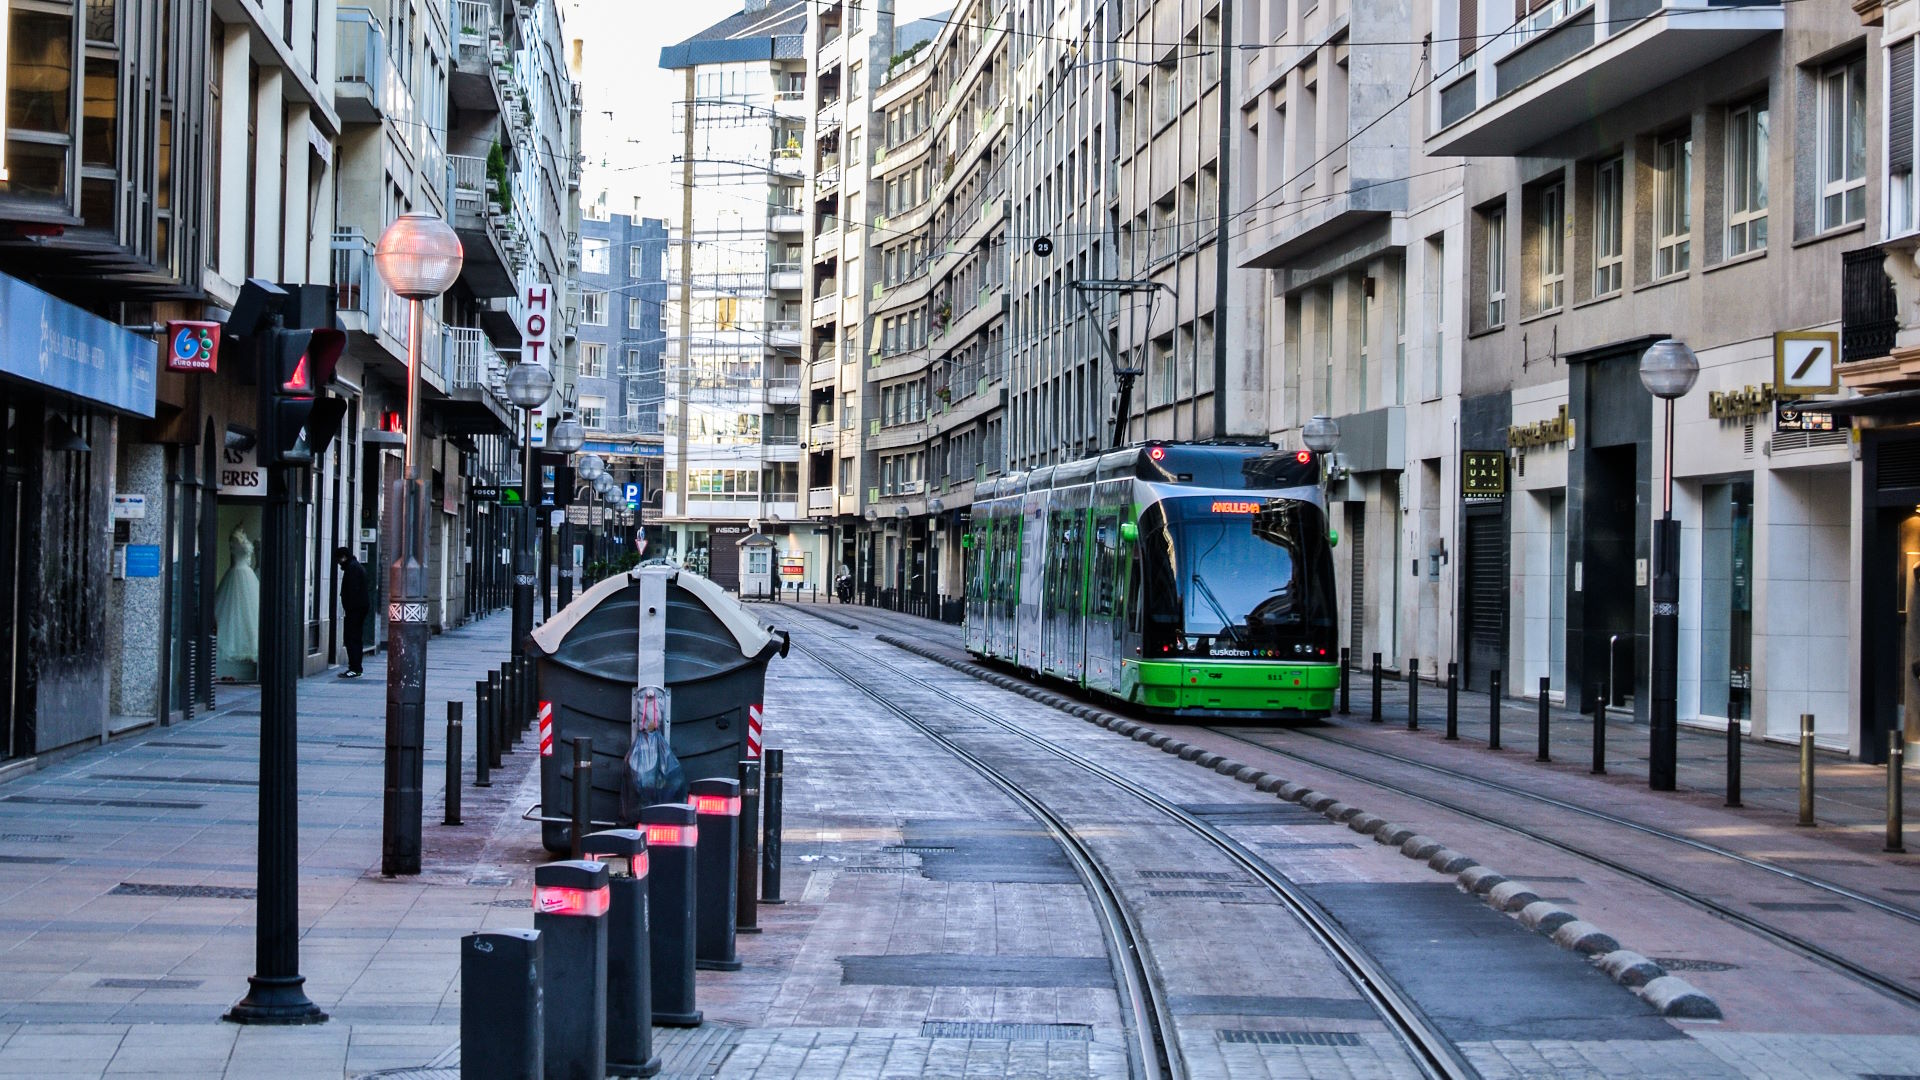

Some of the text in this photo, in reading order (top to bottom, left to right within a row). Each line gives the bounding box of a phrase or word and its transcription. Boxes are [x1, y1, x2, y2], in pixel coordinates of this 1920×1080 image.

[1038, 243, 1049, 251] 25
[222, 471, 258, 487] ERES
[626, 485, 638, 502] P
[1211, 502, 1260, 514] ANGULEMA
[1209, 648, 1250, 657] euskotren
